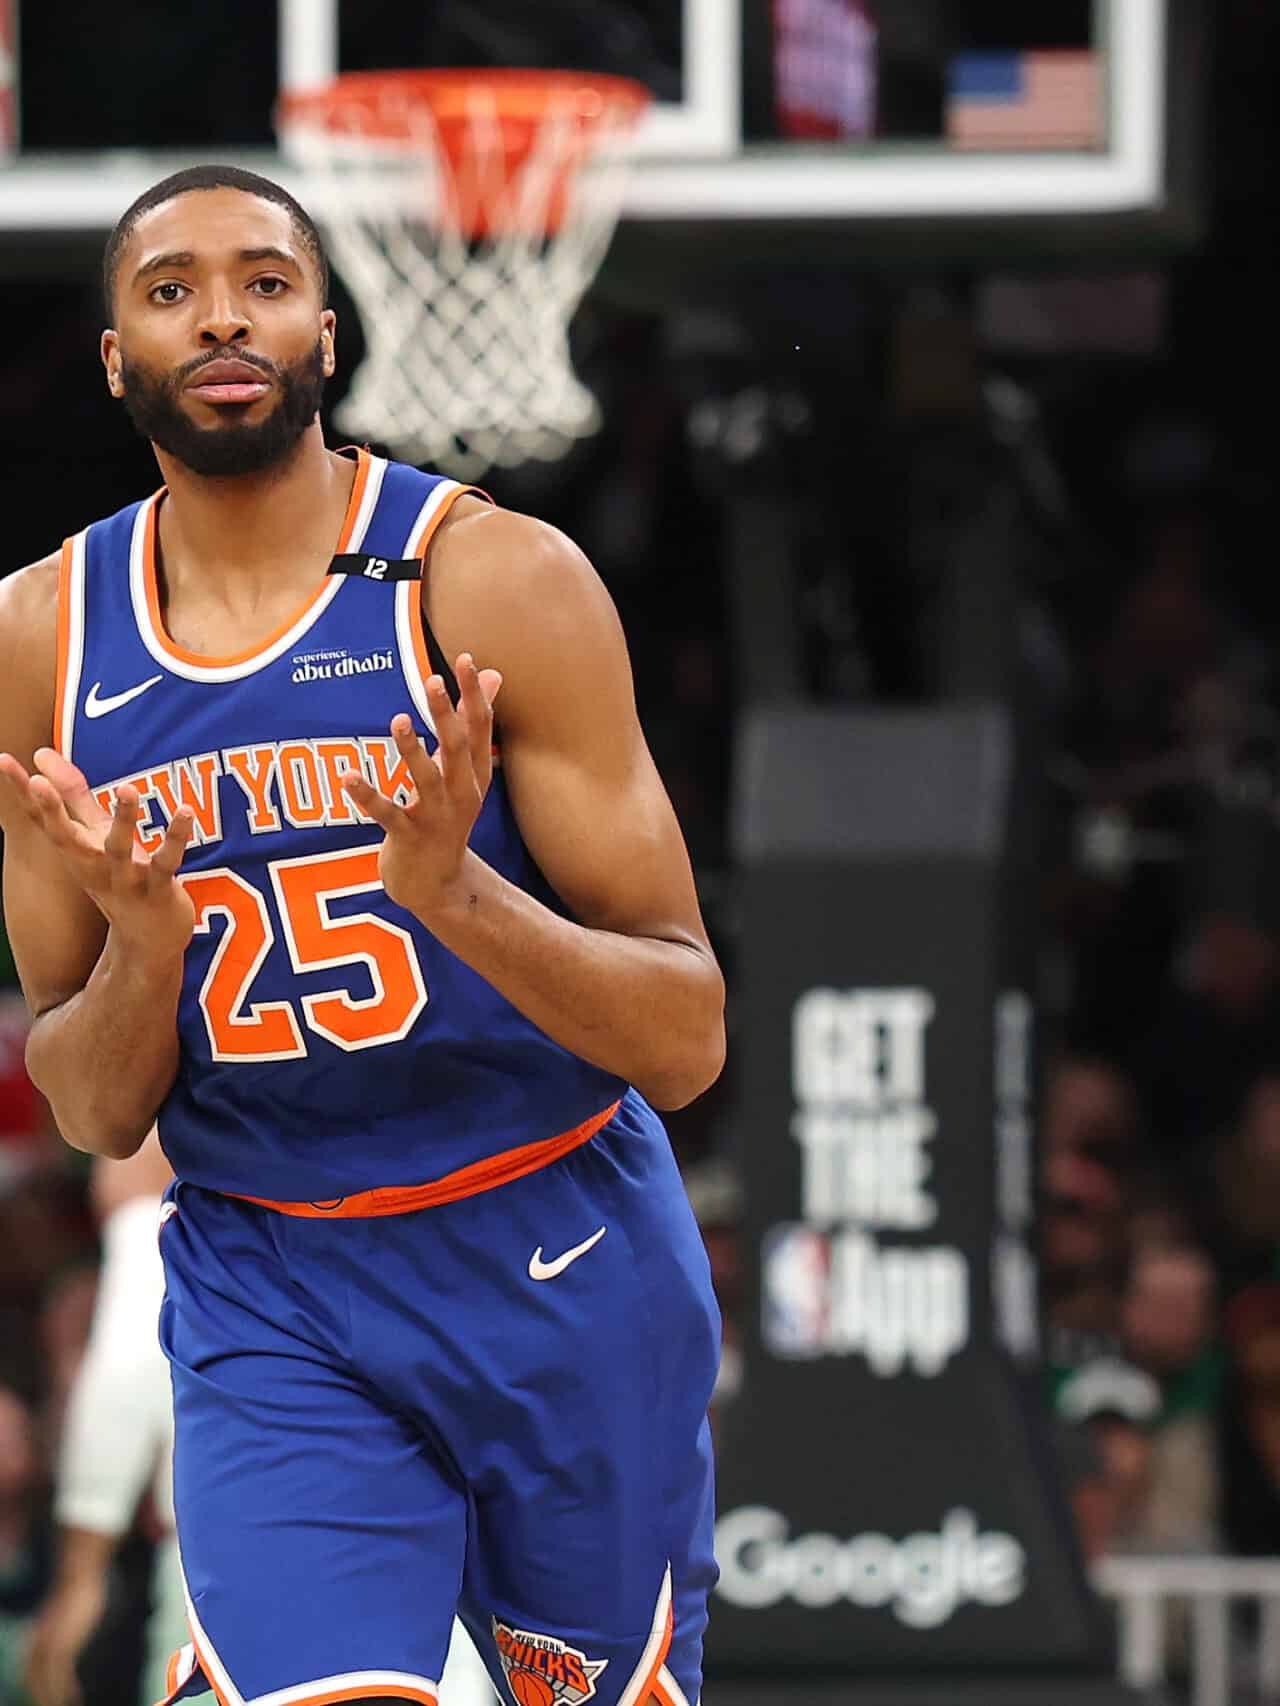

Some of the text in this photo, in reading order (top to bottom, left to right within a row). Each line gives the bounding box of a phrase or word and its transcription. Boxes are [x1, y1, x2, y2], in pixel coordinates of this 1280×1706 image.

[363, 557, 388, 580] 12
[291, 650, 394, 683] abu dhabi
[292, 649, 348, 664] experience
[175, 842, 428, 1062] 25
[716, 1505, 1026, 1628] Google
